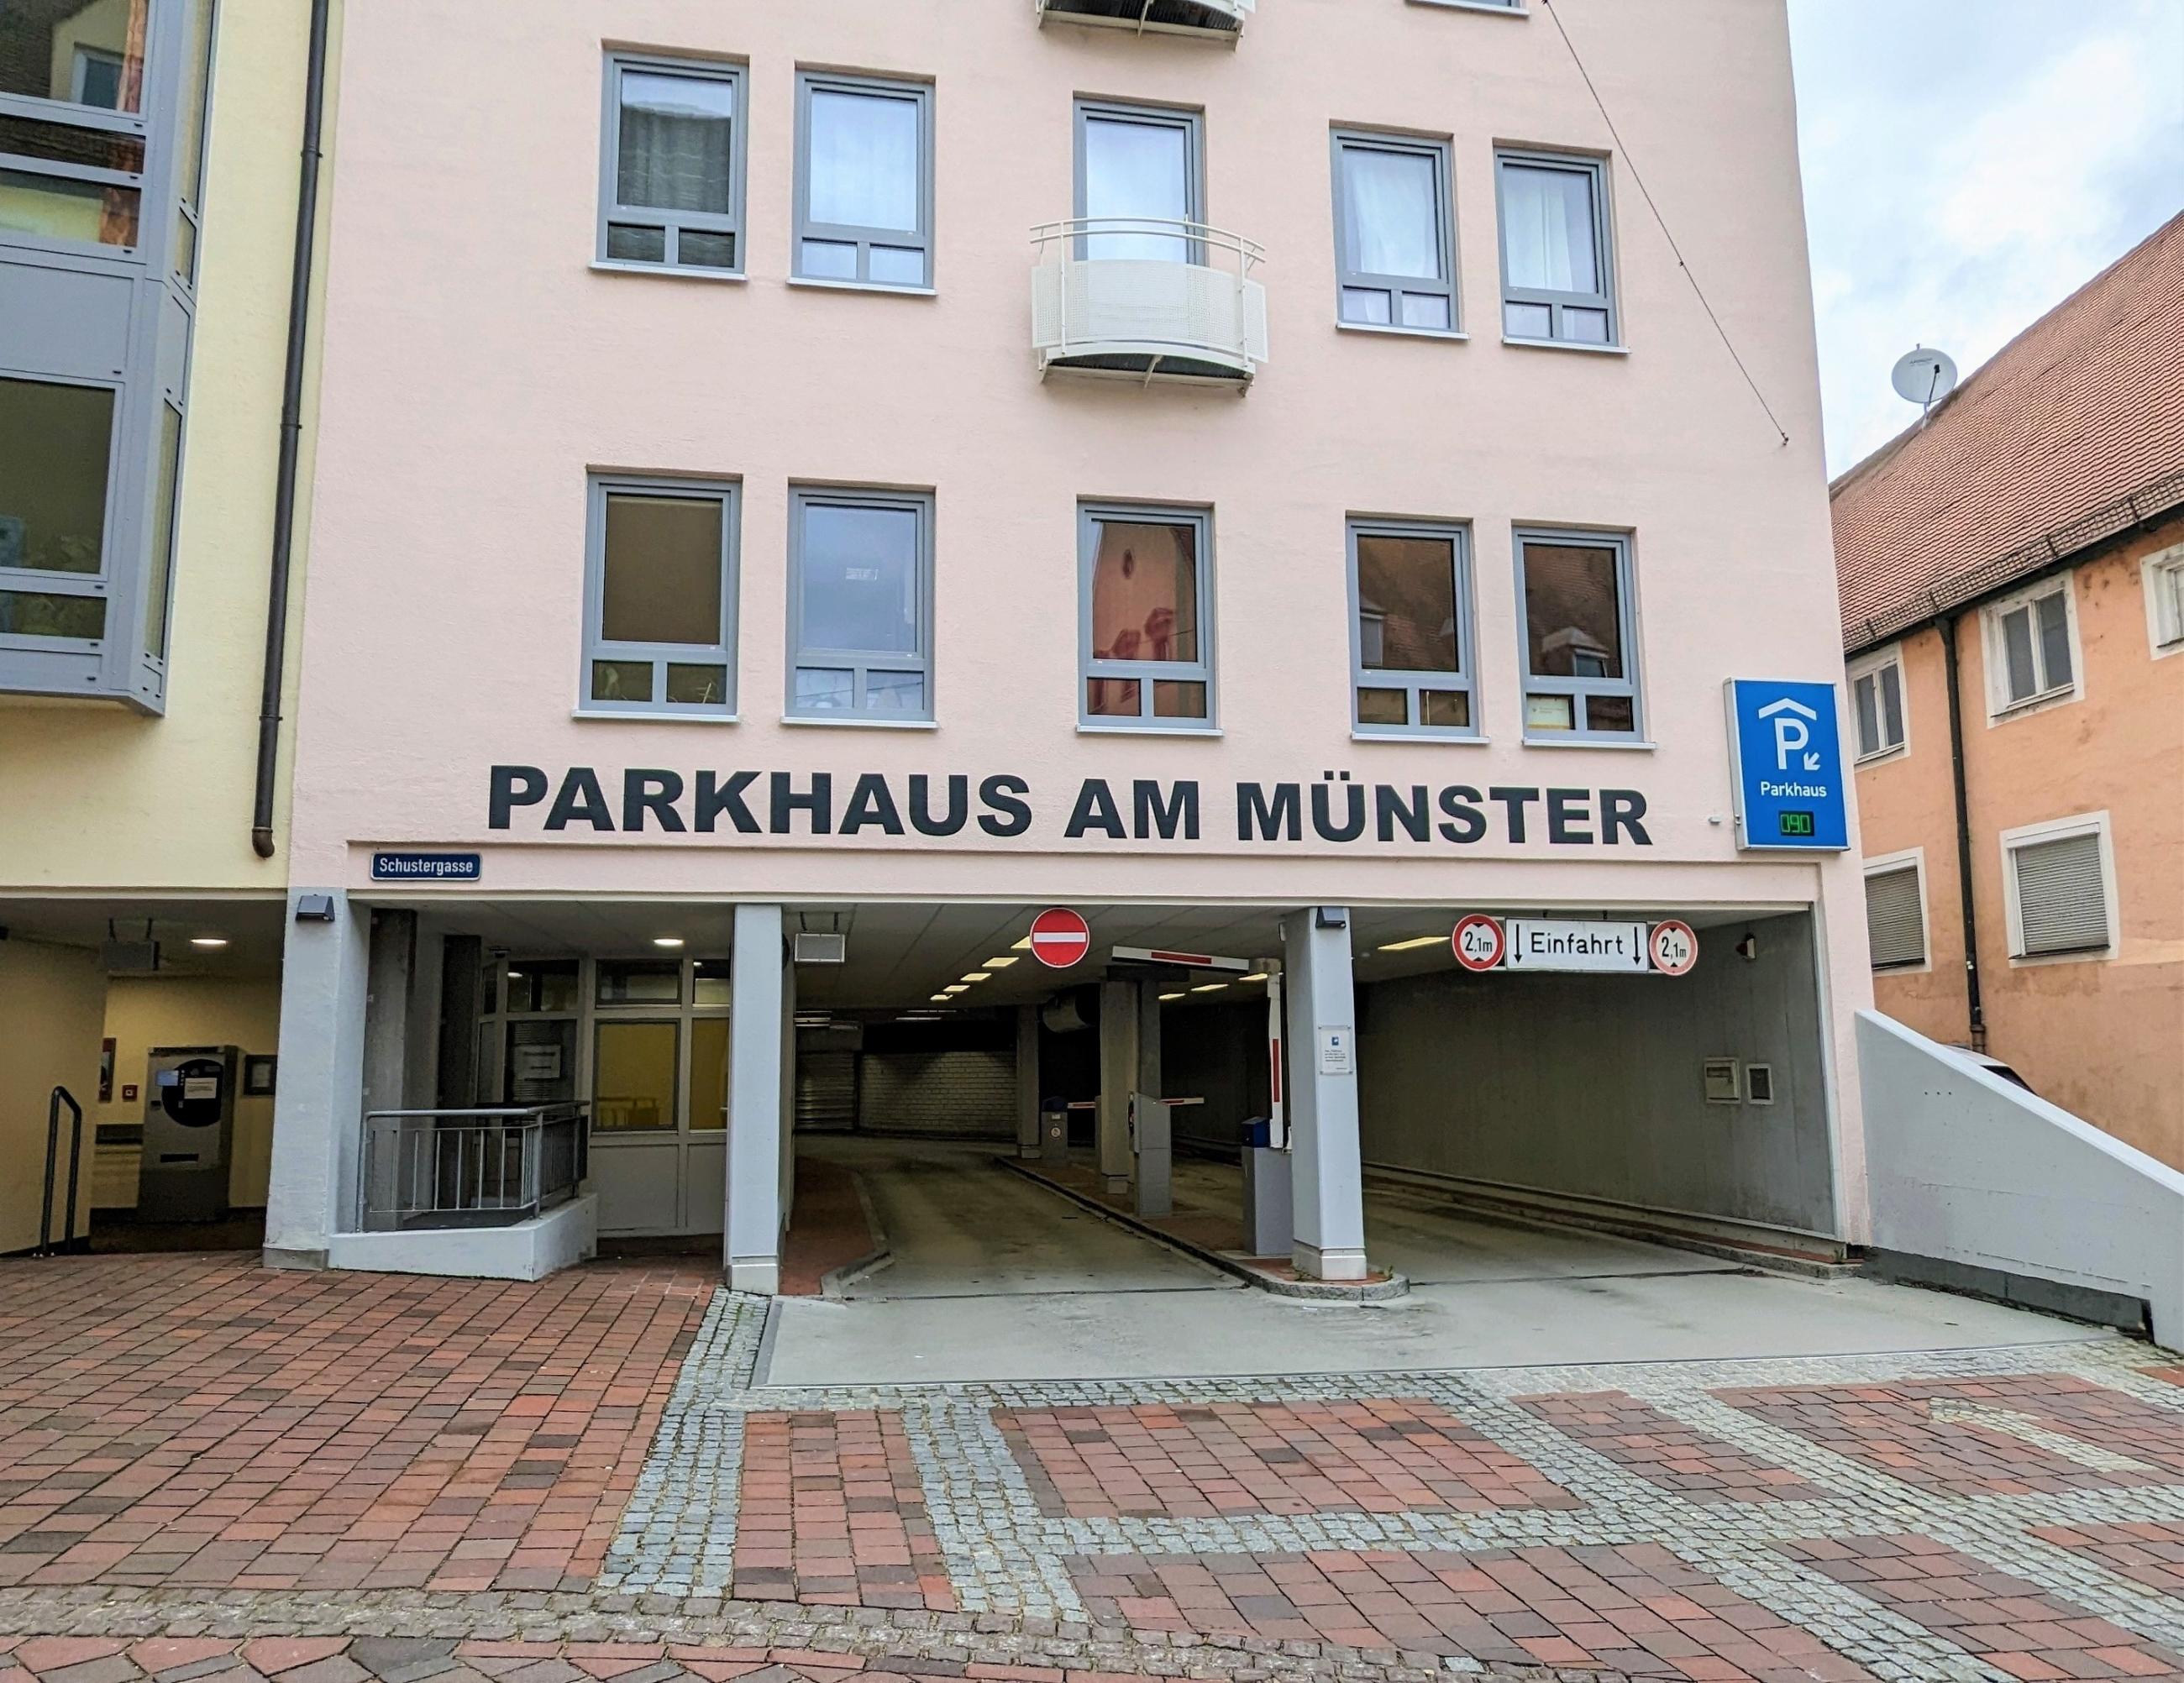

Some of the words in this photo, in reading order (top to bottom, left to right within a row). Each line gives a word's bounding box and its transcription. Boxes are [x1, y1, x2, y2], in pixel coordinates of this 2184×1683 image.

[1774, 717, 1809, 770] P
[1760, 781, 1827, 798] Parkhaus
[488, 765, 1032, 837] PARKHAUS
[1063, 778, 1200, 840] AM
[1236, 770, 1653, 846] MÜNSTER
[1780, 813, 1811, 833] 090
[379, 857, 474, 876] Schustergasse
[1530, 931, 1624, 955] Einfahrt
